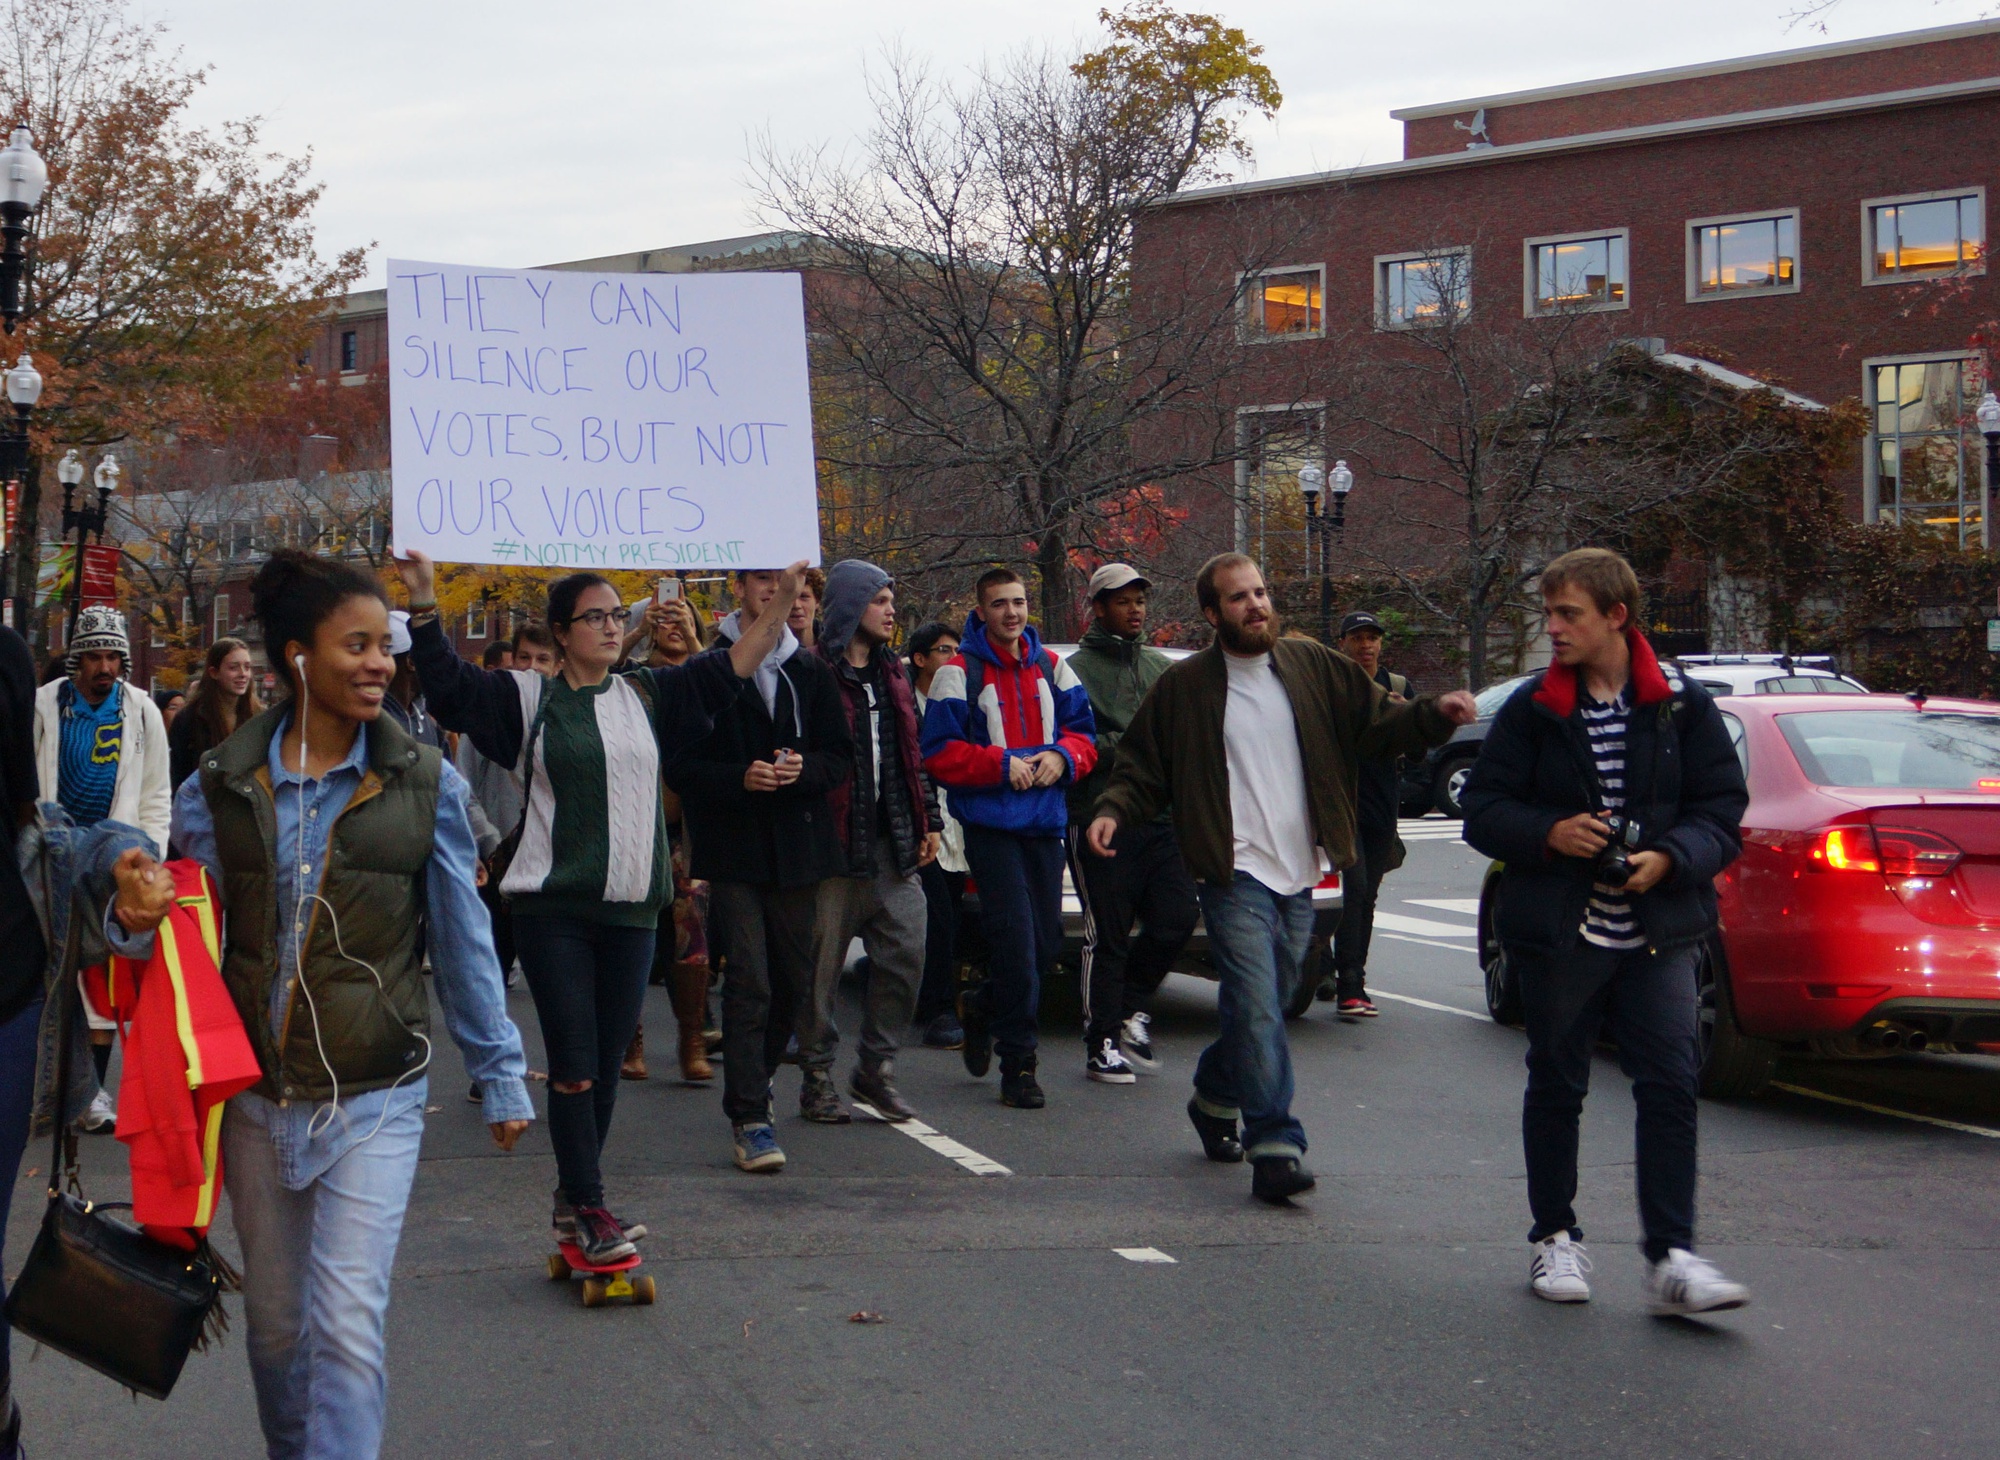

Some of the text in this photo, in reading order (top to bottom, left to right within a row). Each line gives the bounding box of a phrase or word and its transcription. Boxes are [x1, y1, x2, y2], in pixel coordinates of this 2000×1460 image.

[396, 272, 681, 334] THEY CAN
[403, 335, 719, 396] SILENCE OUR
[582, 417, 675, 464] BUT
[696, 423, 788, 466] NOT
[417, 478, 705, 538] OUR VOICES
